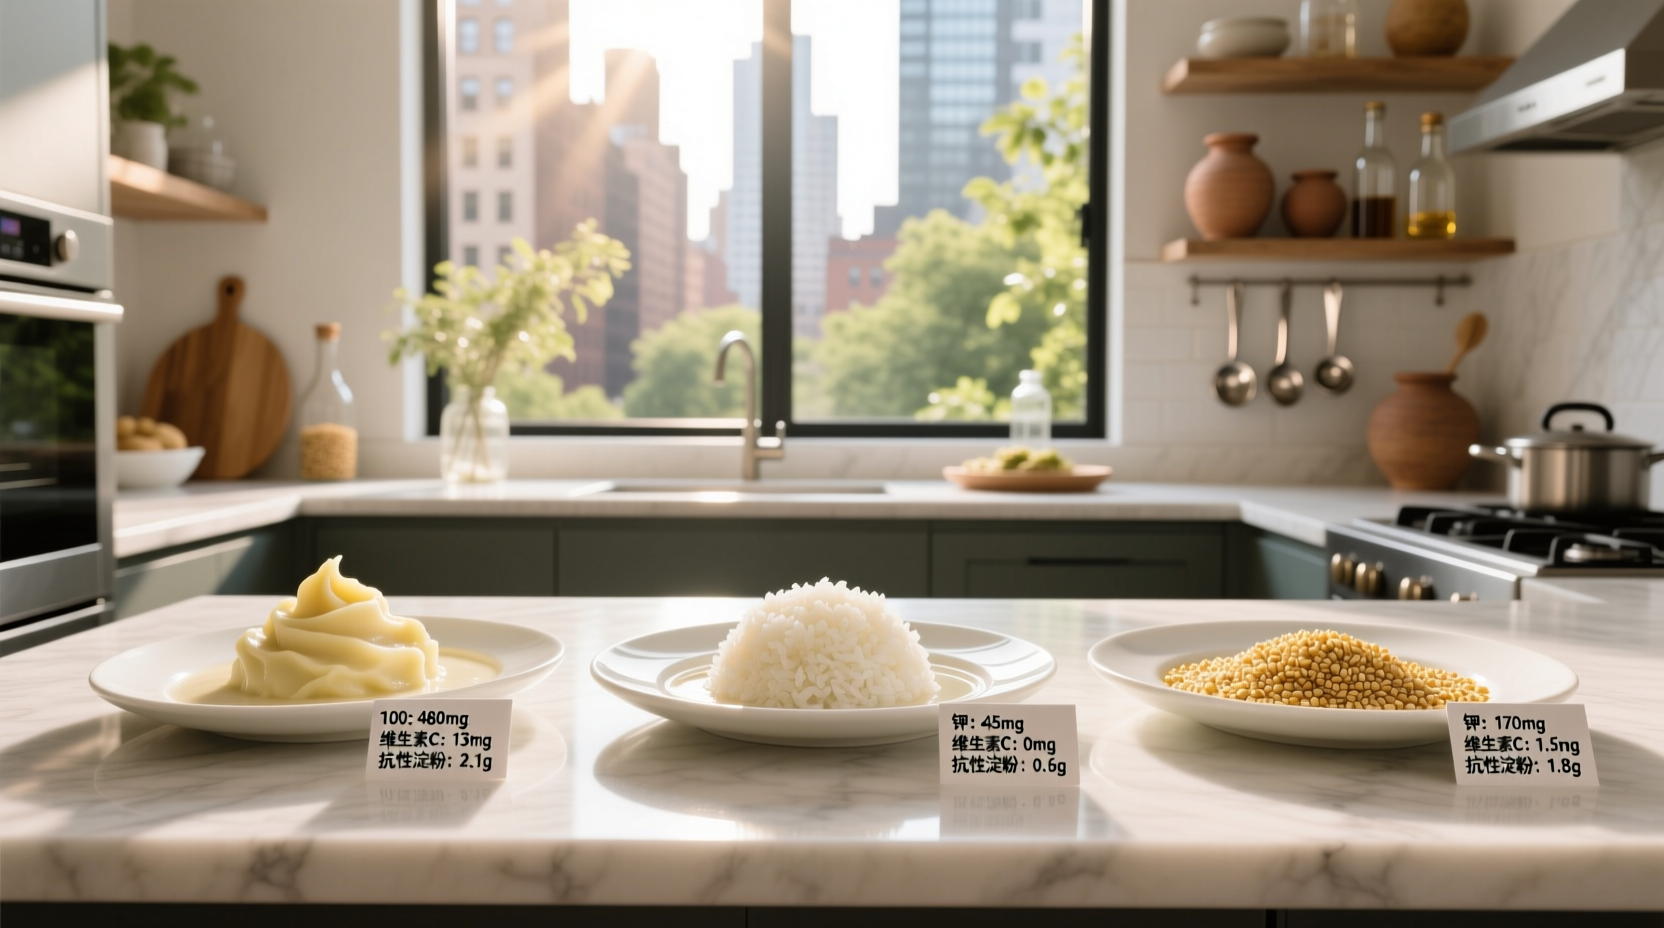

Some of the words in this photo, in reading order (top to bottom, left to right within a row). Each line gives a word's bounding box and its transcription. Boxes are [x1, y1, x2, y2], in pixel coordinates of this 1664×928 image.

[380, 711, 413, 725] 100:
[981, 715, 1024, 734] 45mg
[1495, 716, 1545, 734] 170mg
[453, 732, 492, 751] 13mg
[1023, 737, 1056, 755] 0mg
[460, 753, 492, 772] 2.1g
[1033, 758, 1066, 776] 0.6g
[1547, 758, 1581, 777] 1.8g
